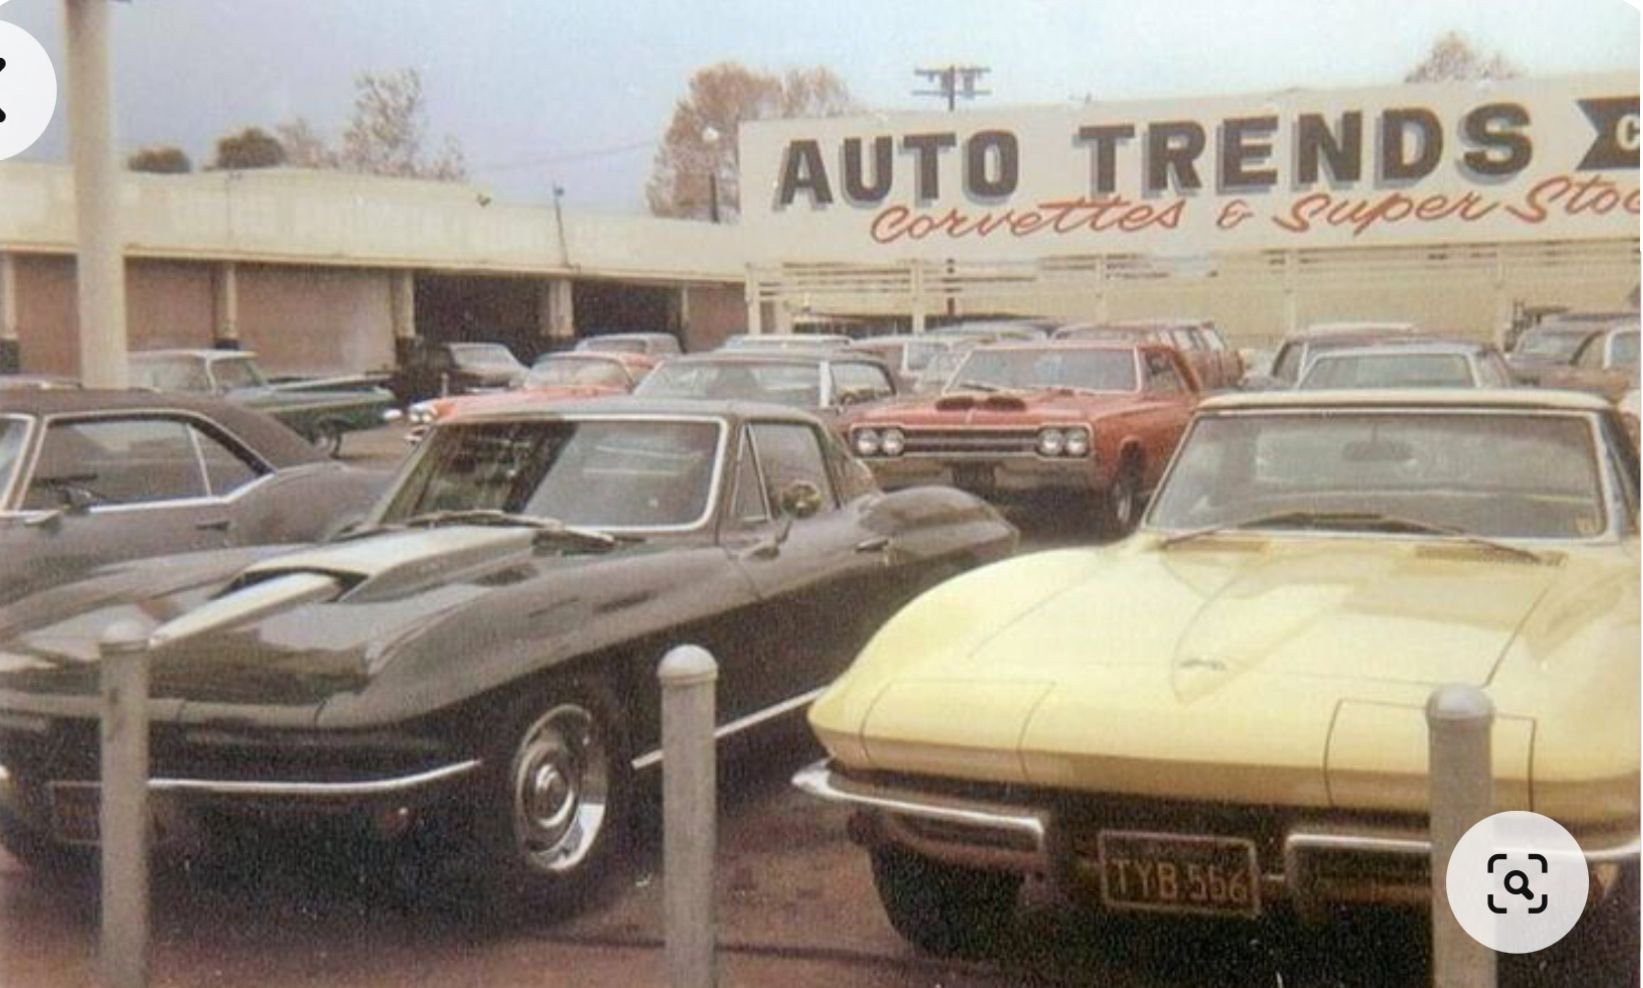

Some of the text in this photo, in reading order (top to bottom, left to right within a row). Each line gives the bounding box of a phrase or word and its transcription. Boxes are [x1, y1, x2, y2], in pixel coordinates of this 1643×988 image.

[773, 102, 1533, 208] AUTO TRENDS
[870, 197, 1186, 243] Corvettes
[1216, 199, 1254, 230] &
[1271, 191, 1500, 236] Super
